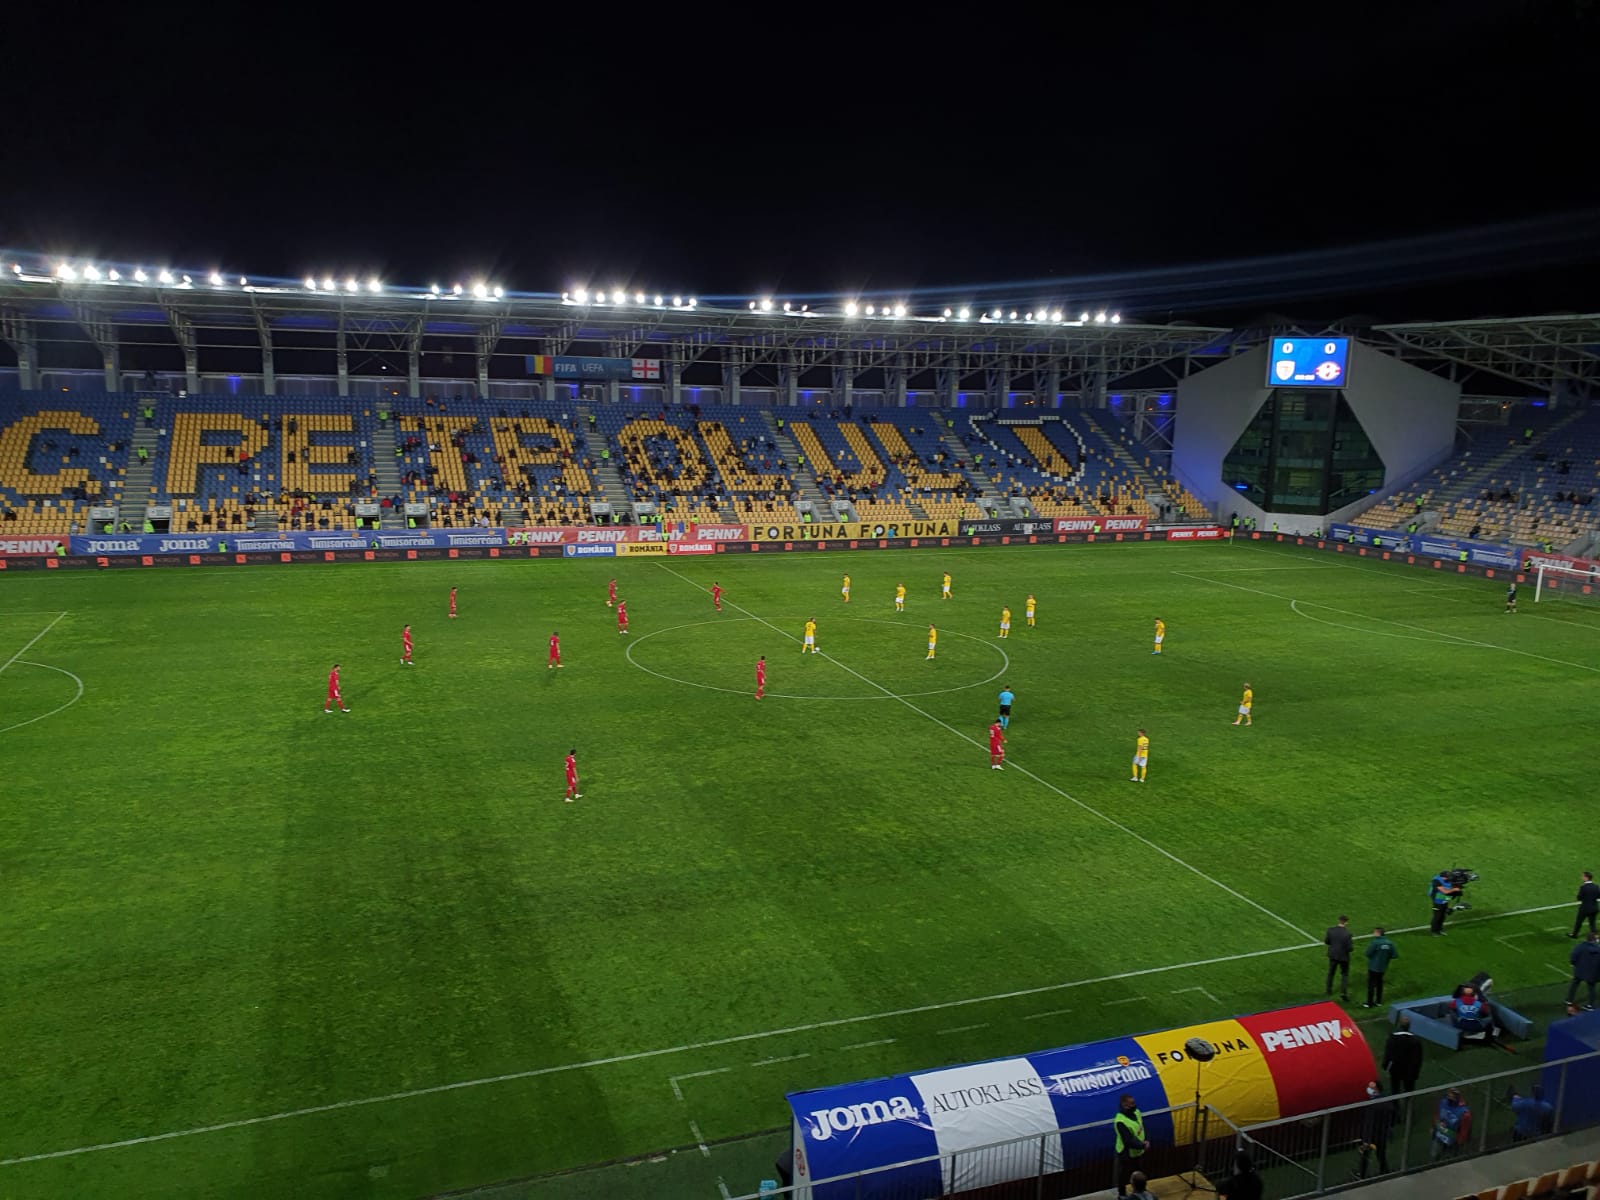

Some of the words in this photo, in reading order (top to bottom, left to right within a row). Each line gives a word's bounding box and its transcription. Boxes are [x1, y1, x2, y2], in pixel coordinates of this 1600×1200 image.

[555, 363, 577, 372] FIFA
[582, 363, 604, 372] UEFA
[860, 522, 950, 538] FORTUNA
[961, 523, 1001, 532] ATOKLASS
[1058, 520, 1096, 531] PENNY
[1105, 520, 1142, 530] PENNY
[577, 530, 626, 542] PENNY
[698, 528, 743, 540] PENNY
[753, 525, 848, 540] FORTUNA
[1261, 1020, 1342, 1052] PENNY
[1157, 1038, 1250, 1065] FOUNA
[932, 1077, 1042, 1115] AUTOKLASS
